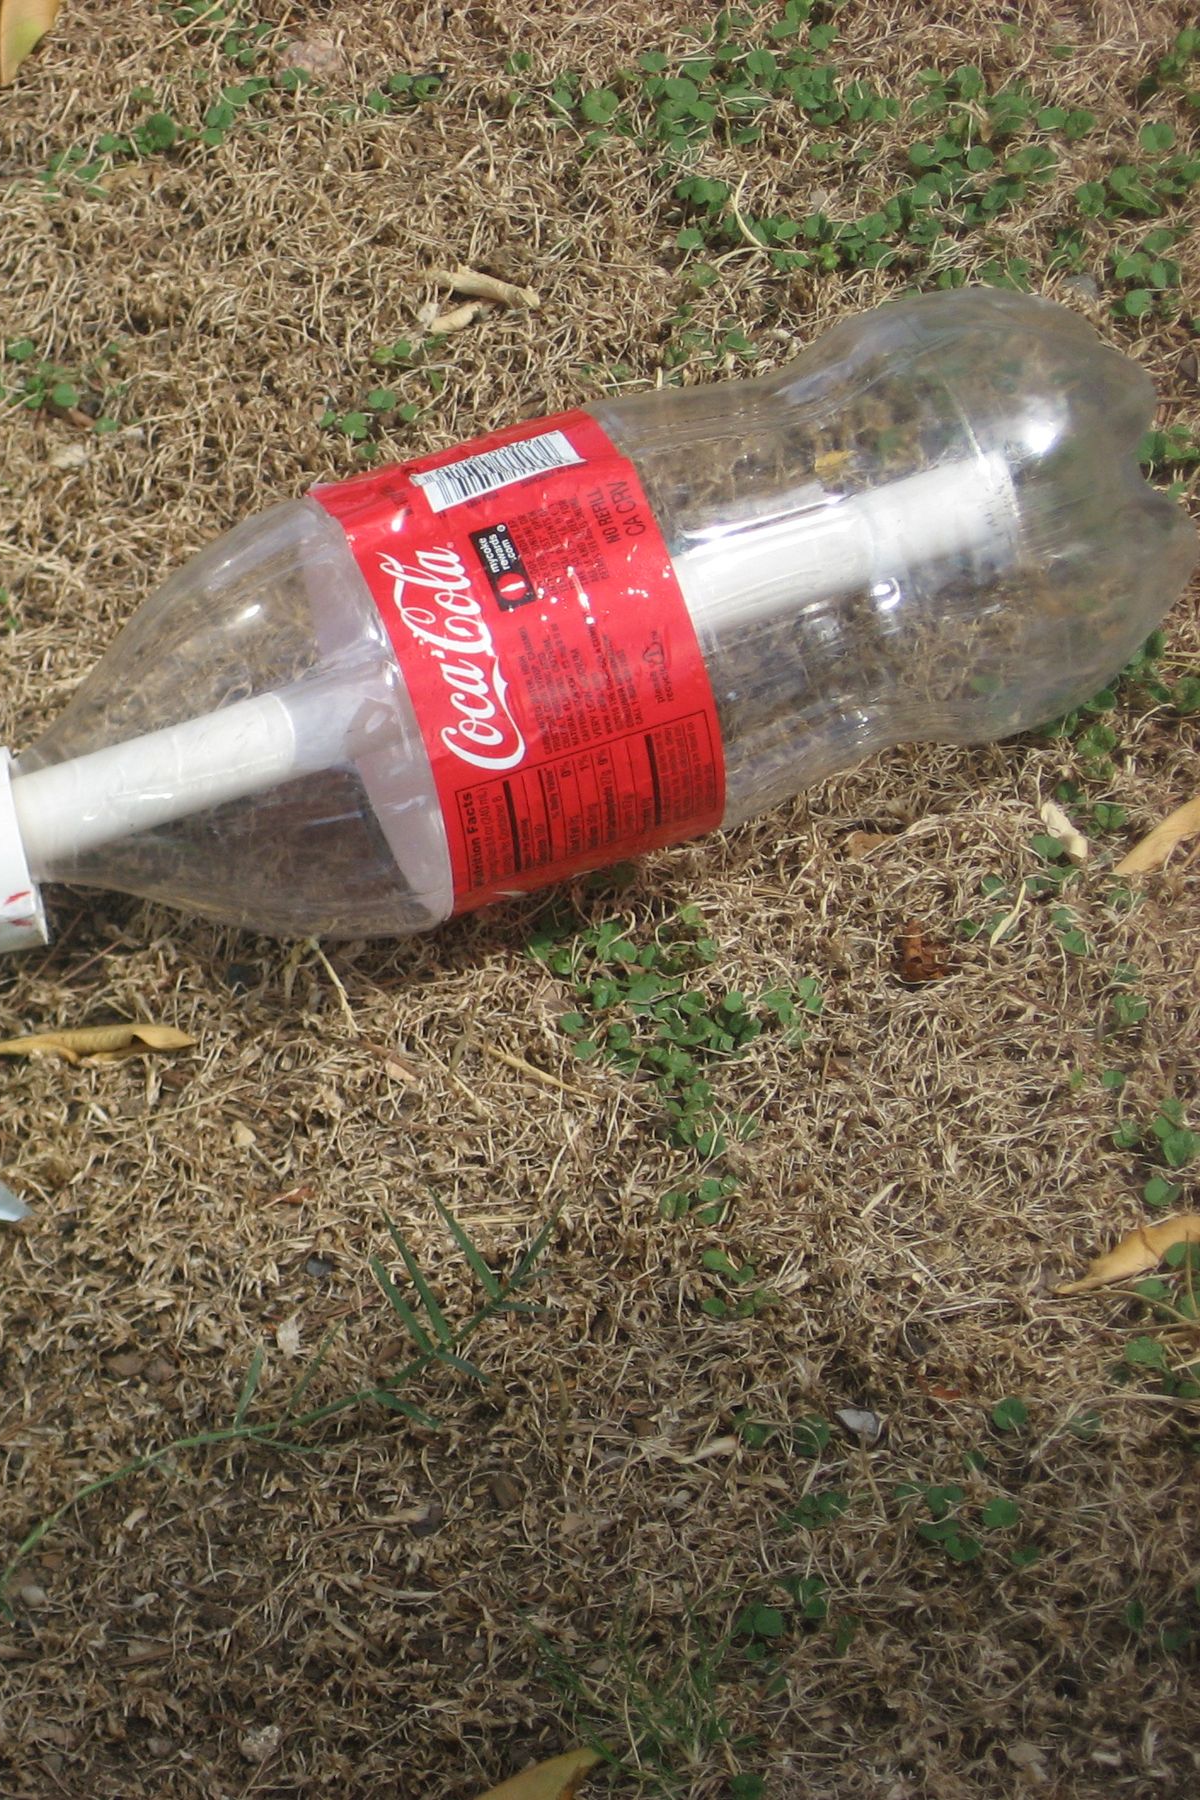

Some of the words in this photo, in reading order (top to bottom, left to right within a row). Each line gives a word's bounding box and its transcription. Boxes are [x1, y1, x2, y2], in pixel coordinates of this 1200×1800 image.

[585, 486, 613, 527] REFILL
[605, 477, 637, 515] CRV
[600, 525, 621, 544] NO
[620, 513, 647, 538] CA
[477, 536, 501, 573] mycoke
[487, 533, 510, 571] rewards
[462, 792, 478, 834] Facts
[471, 837, 482, 887] Nutrition
